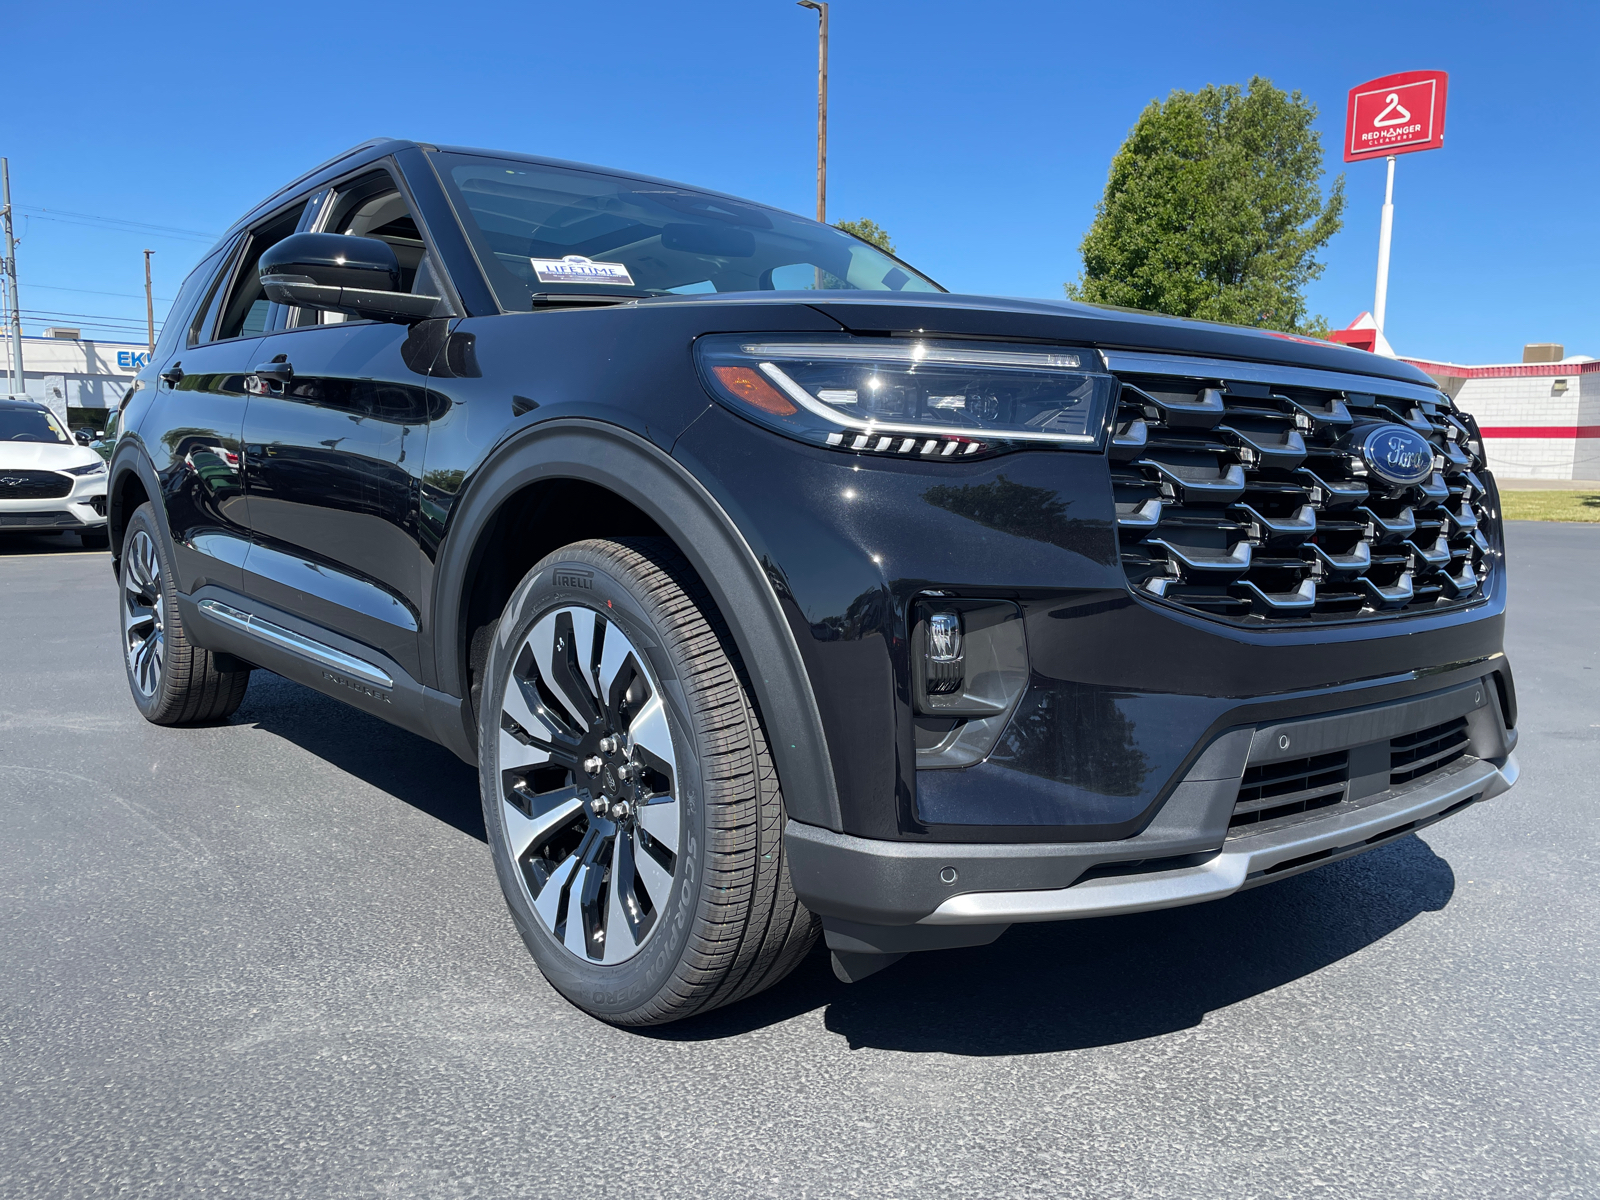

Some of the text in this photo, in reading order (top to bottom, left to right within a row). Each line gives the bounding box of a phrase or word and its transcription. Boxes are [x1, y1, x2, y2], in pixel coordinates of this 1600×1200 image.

[1362, 132, 1380, 141] RED
[1368, 134, 1413, 145] CLEANERS
[545, 265, 617, 275] LIFETIME
[1387, 436, 1424, 468] Ford
[552, 567, 595, 590] PIRELLI
[321, 671, 393, 705] EXPLORER
[645, 830, 697, 984] SCORPION
